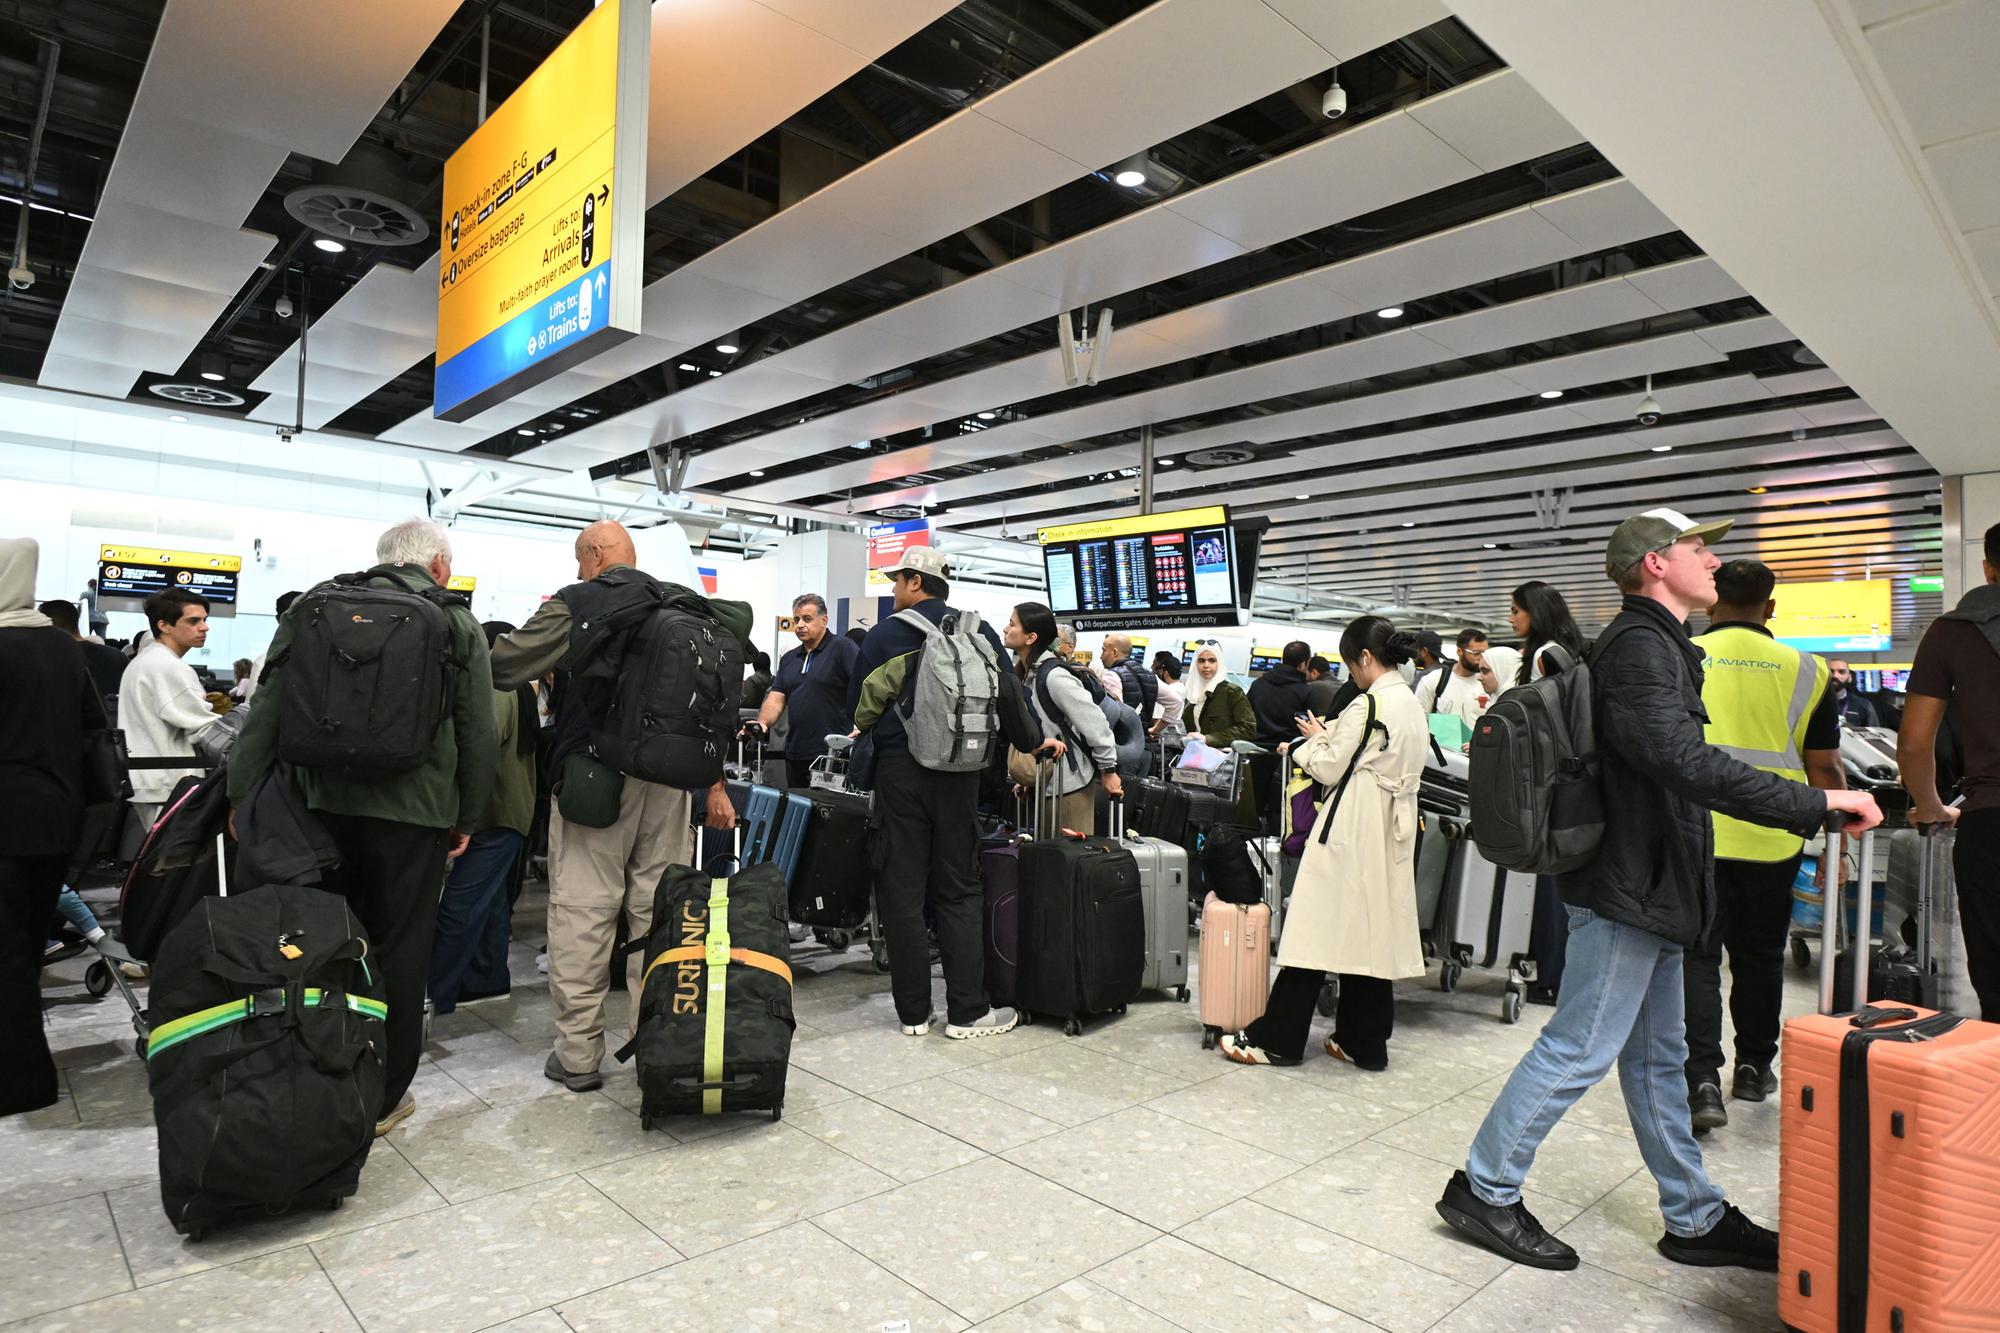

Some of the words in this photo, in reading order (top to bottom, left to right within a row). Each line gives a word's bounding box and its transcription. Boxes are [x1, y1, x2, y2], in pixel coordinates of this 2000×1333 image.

[461, 187, 491, 222] Check-in
[492, 169, 511, 196] zone
[513, 151, 528, 178] F-G
[460, 220, 477, 240] Hotels
[553, 217, 569, 237] Lifts
[570, 208, 581, 224] to:
[458, 244, 489, 274] Oversize
[490, 213, 525, 249] baggage
[542, 229, 580, 267] Arrivals
[499, 285, 533, 315] Multi-faith
[534, 268, 557, 295] prayer
[559, 255, 579, 276] room
[549, 301, 566, 320] Lifts
[566, 293, 578, 309] to:
[547, 316, 578, 344] Trains
[1076, 526, 1113, 536] information
[1092, 620, 1124, 629] departures
[1125, 620, 1141, 629] gates
[1142, 617, 1173, 627] displayed
[1174, 616, 1189, 624] after
[1190, 615, 1217, 625] security
[1717, 658, 1782, 670] AVIATION
